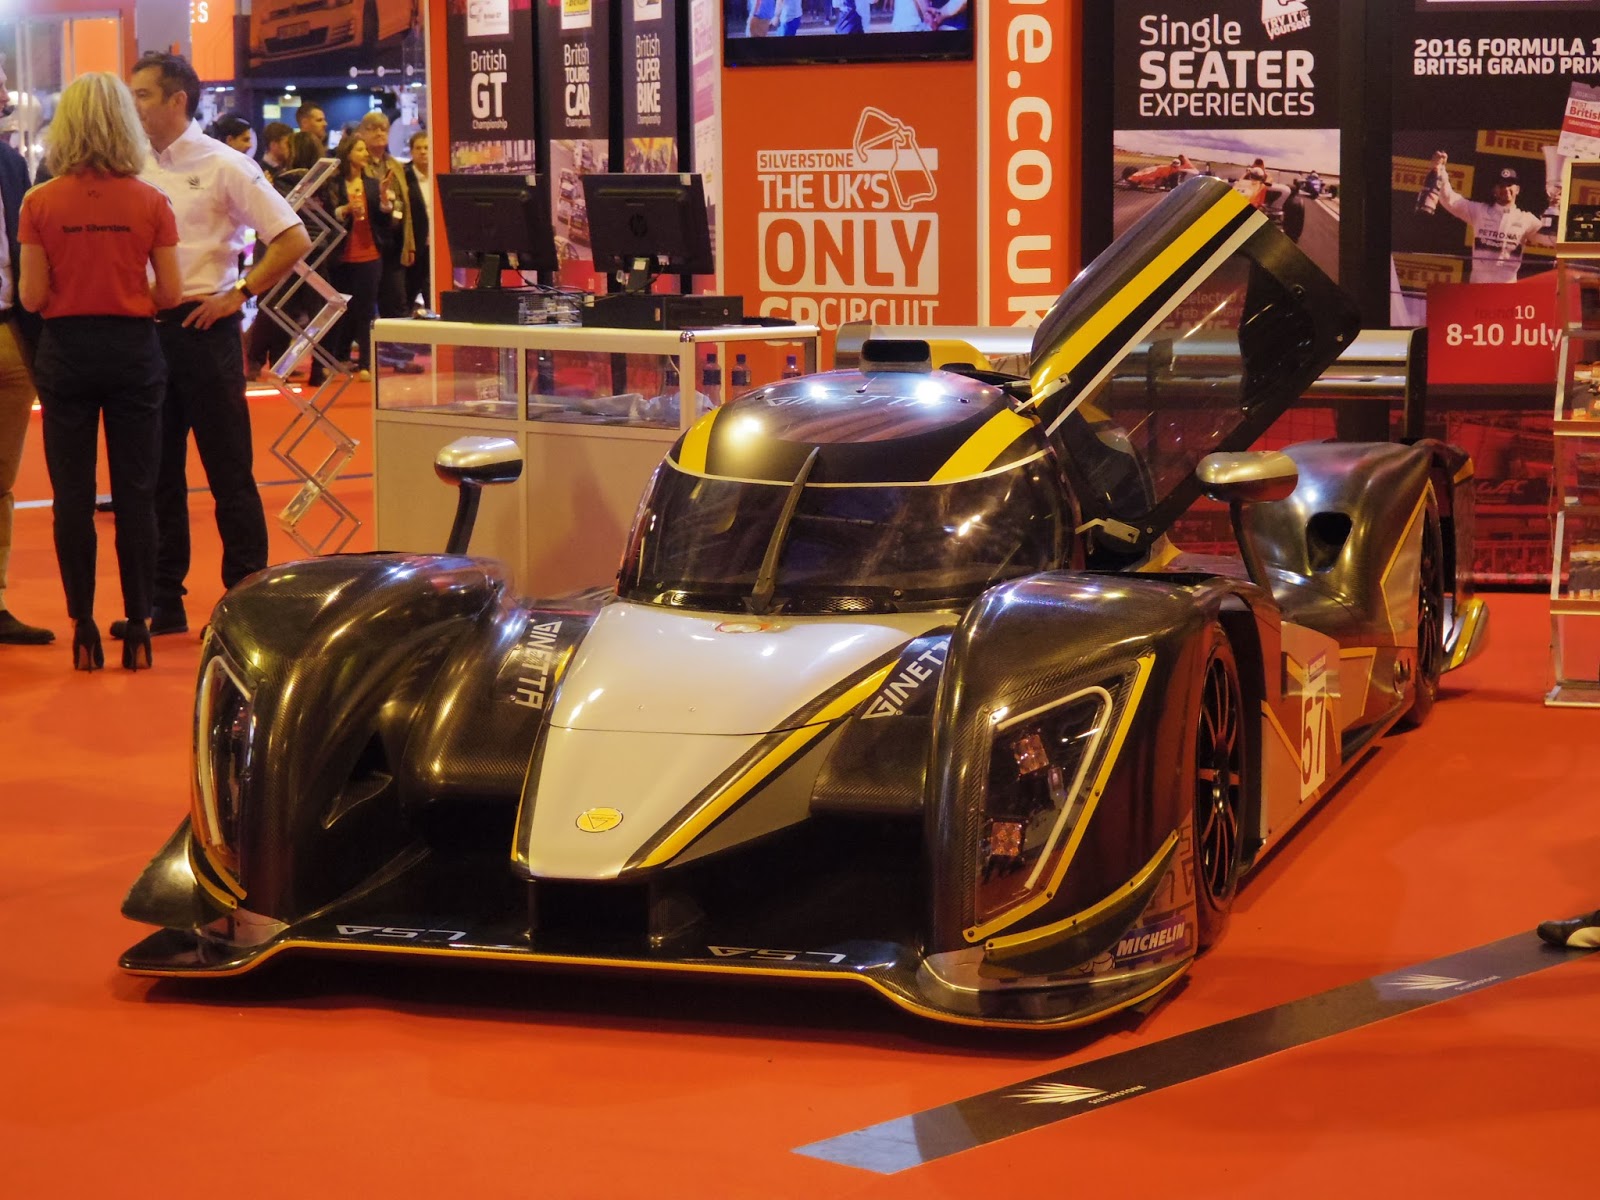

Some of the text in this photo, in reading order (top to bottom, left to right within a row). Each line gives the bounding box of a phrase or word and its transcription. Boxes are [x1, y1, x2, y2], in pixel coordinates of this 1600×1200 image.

[636, 33, 661, 58] British
[1139, 14, 1242, 52] Single
[1414, 38, 1472, 57] 2016
[1478, 37, 1586, 57] FORMULA
[471, 49, 507, 72] British
[564, 42, 590, 66] British
[1487, 57, 1555, 75] GRAND
[1559, 57, 1600, 74] PRIX
[636, 58, 660, 82] SUPER
[1139, 50, 1315, 89] SEATER
[470, 72, 507, 119] GT
[565, 83, 591, 116] CAR
[637, 82, 661, 113] BIKE
[1139, 92, 1315, 117] EXPERIENCES
[759, 152, 854, 169] SILVERSTONE
[757, 174, 814, 209] THE
[764, 218, 932, 287] ONLY
[1515, 305, 1535, 320] 10
[1446, 322, 1563, 351] 8-10 July
[1302, 686, 1325, 786] 57
[1116, 922, 1185, 957] MICHELIN
